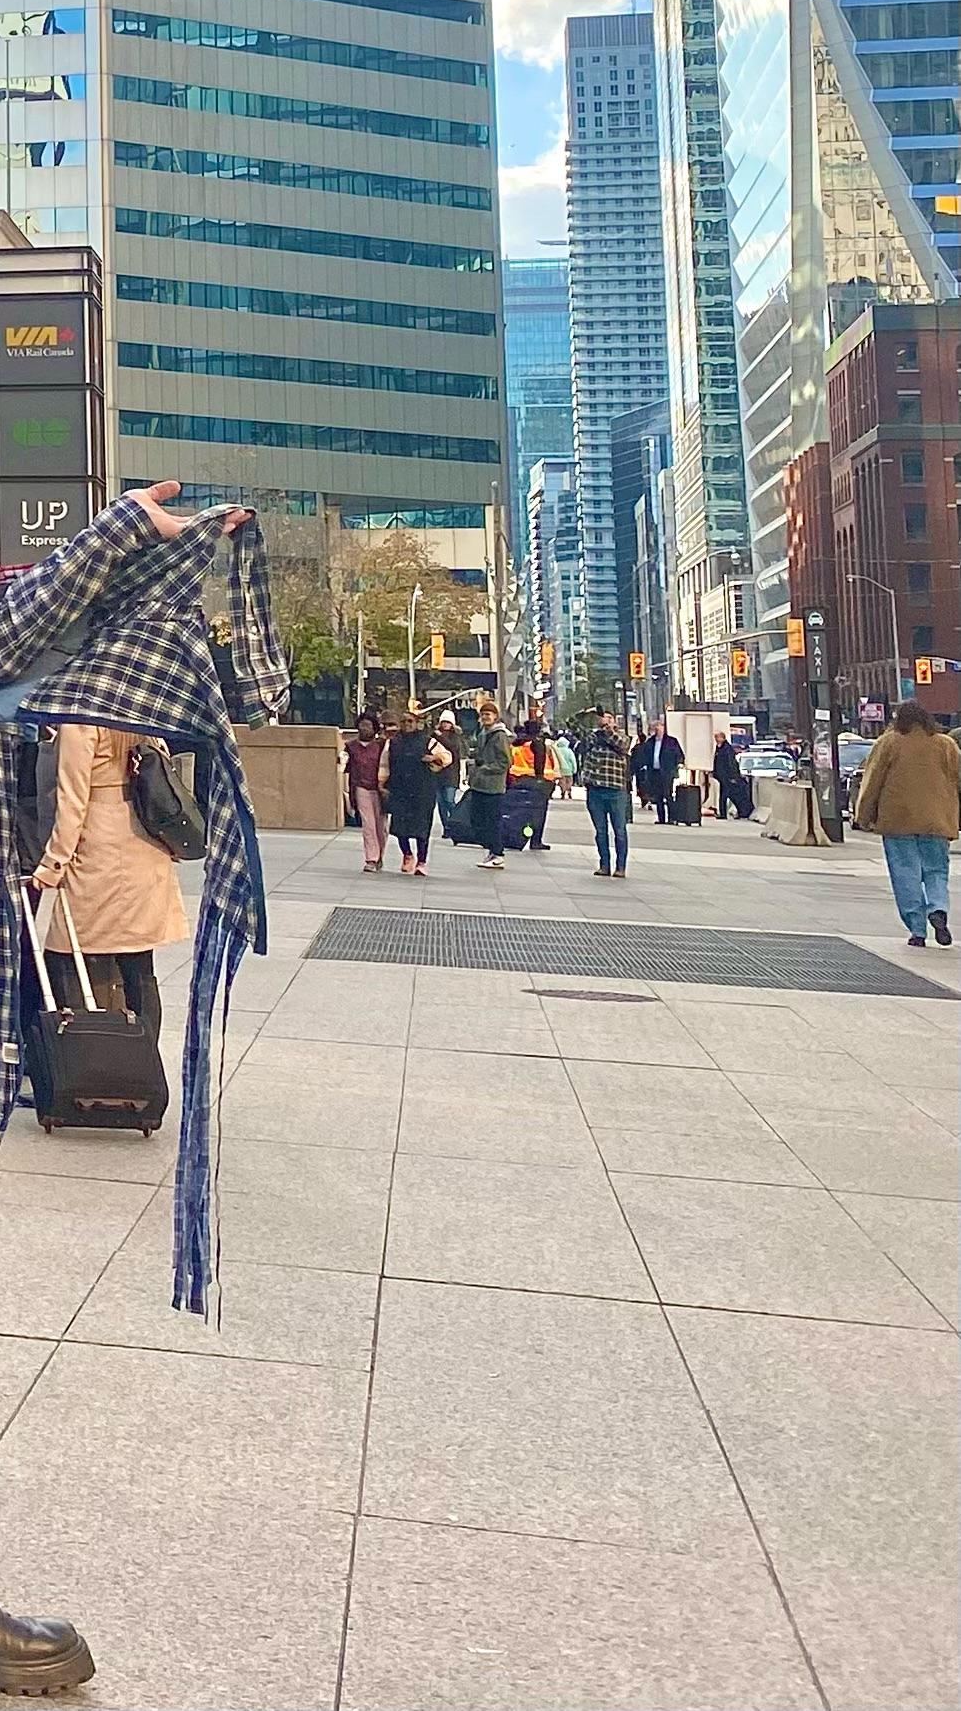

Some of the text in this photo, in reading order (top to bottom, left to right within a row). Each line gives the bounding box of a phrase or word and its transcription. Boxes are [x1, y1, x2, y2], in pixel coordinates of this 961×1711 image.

[6, 326, 58, 347] VIA
[6, 348, 25, 358] VIA
[26, 347, 43, 358] Rail
[22, 500, 68, 530] UP
[21, 534, 69, 548] Express
[813, 635, 822, 677] TAXI
